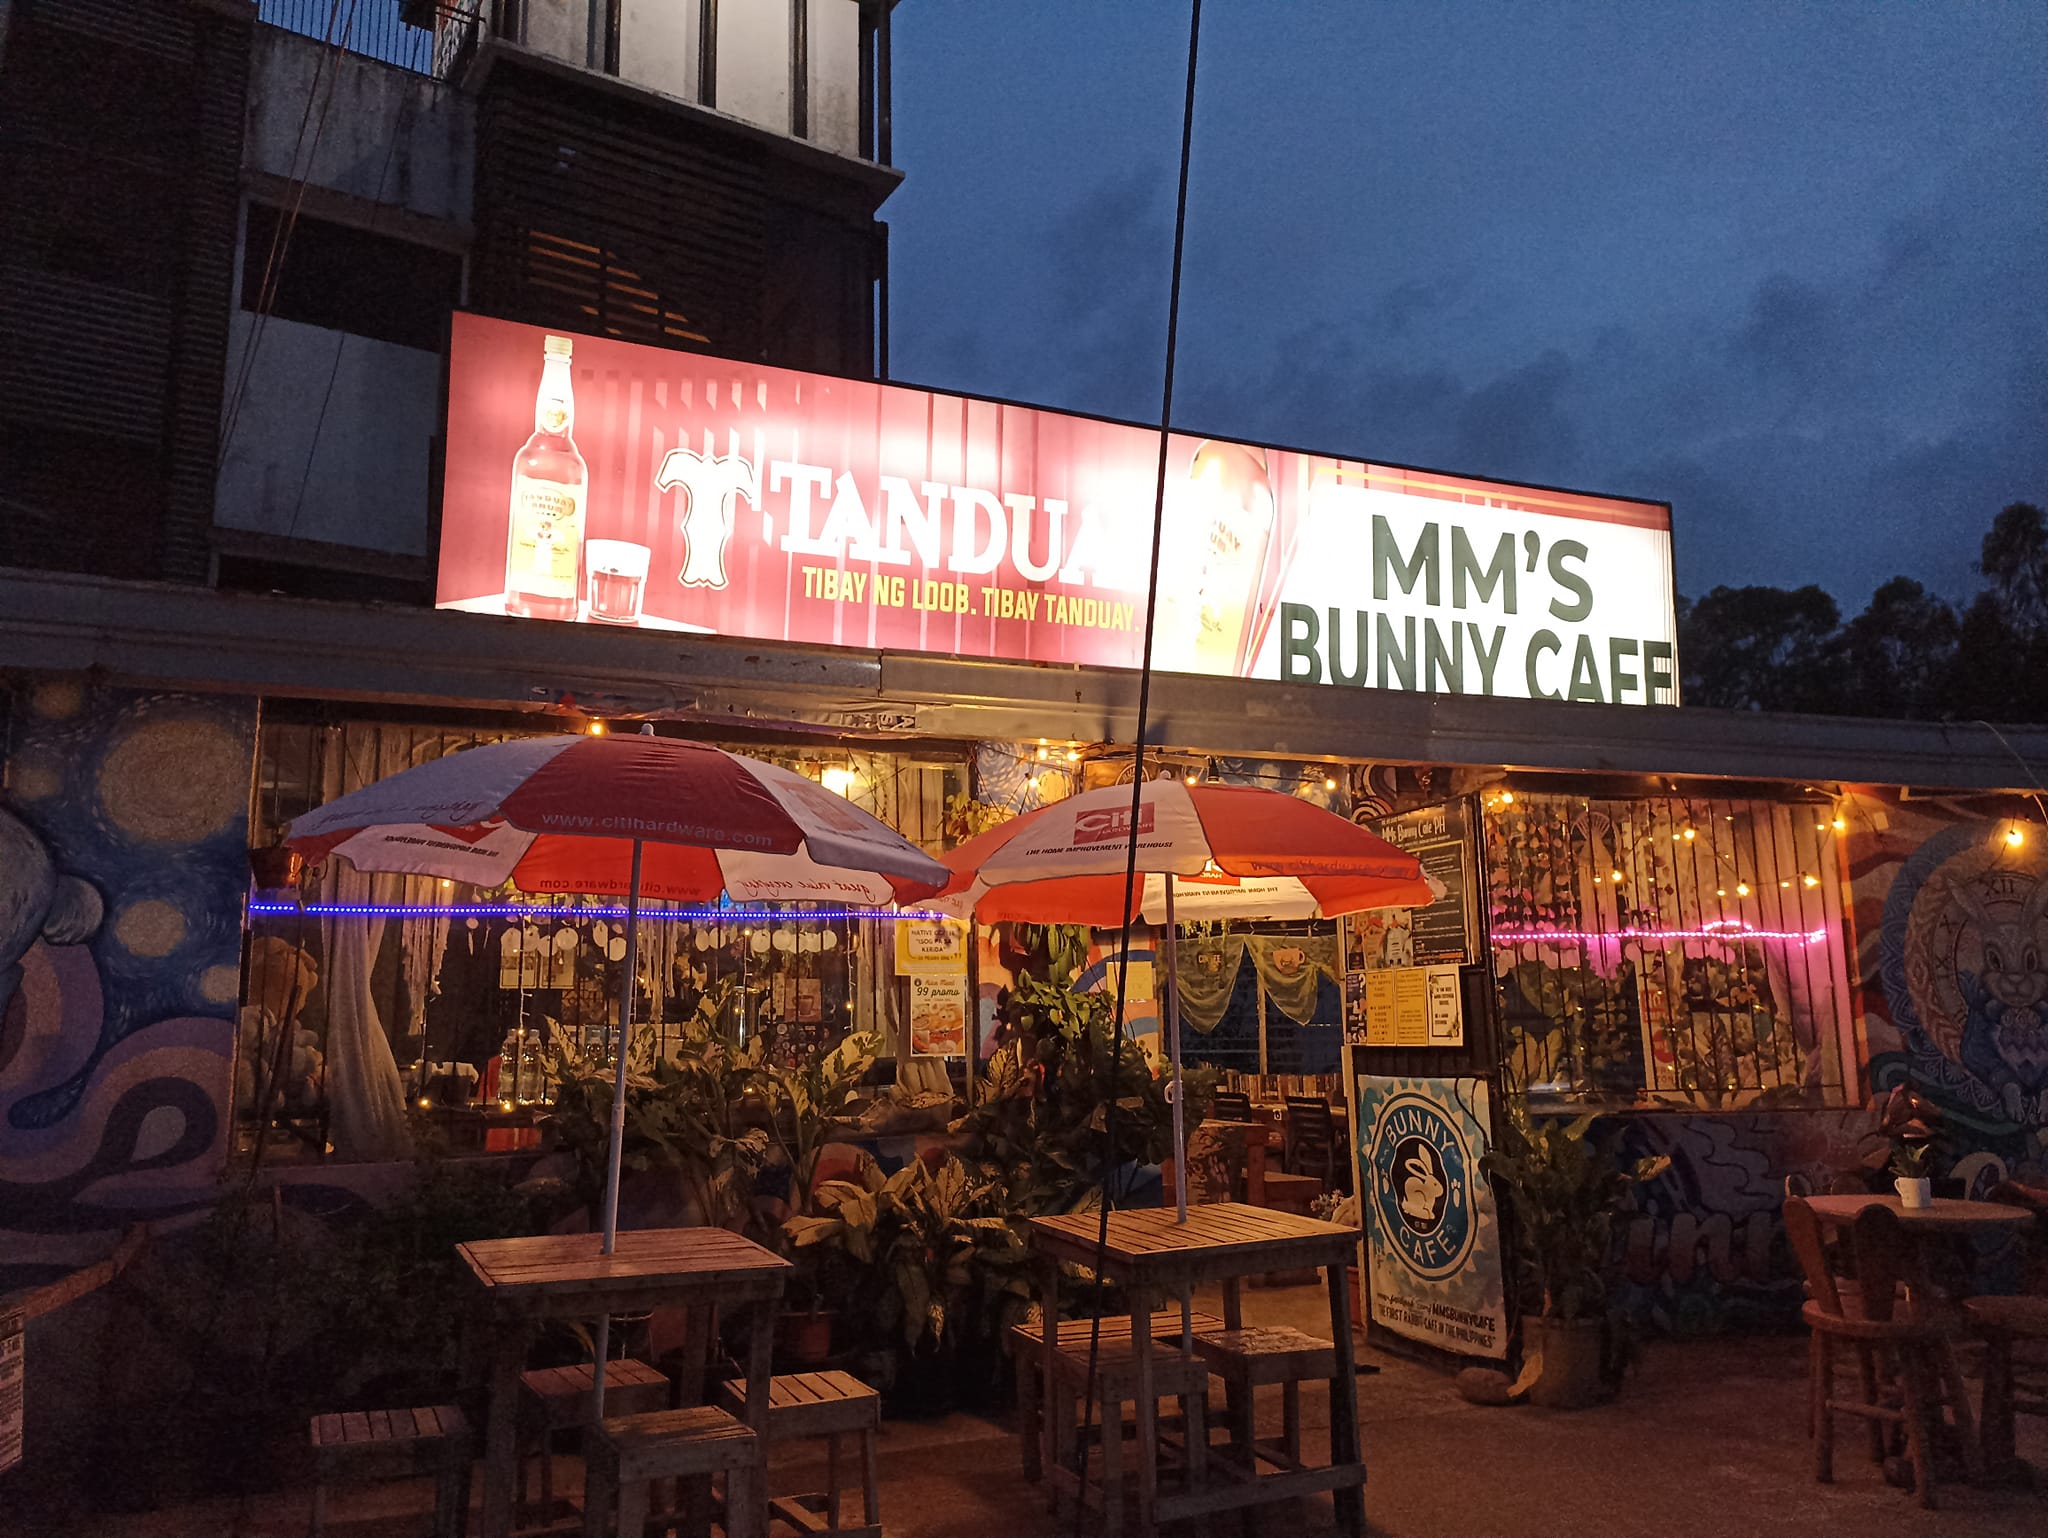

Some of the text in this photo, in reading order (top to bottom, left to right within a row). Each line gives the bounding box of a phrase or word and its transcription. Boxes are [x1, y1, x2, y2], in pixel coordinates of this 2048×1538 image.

[769, 459, 1152, 592] TANDUA
[1371, 514, 1594, 622] MM'S
[802, 566, 1140, 632] TIBAY NG LOOB. TIBAY TANDUAY.
[1280, 602, 1672, 705] BUNNY CAFE
[542, 813, 773, 847] www.citihardware.com
[1433, 815, 1446, 835] PH
[1041, 847, 1063, 855] HOME
[917, 986, 960, 998] 99 promo
[1385, 1109, 1454, 1152] BUNNY
[1399, 1225, 1456, 1265] CAFE
[1386, 1306, 1402, 1321] FIRST
